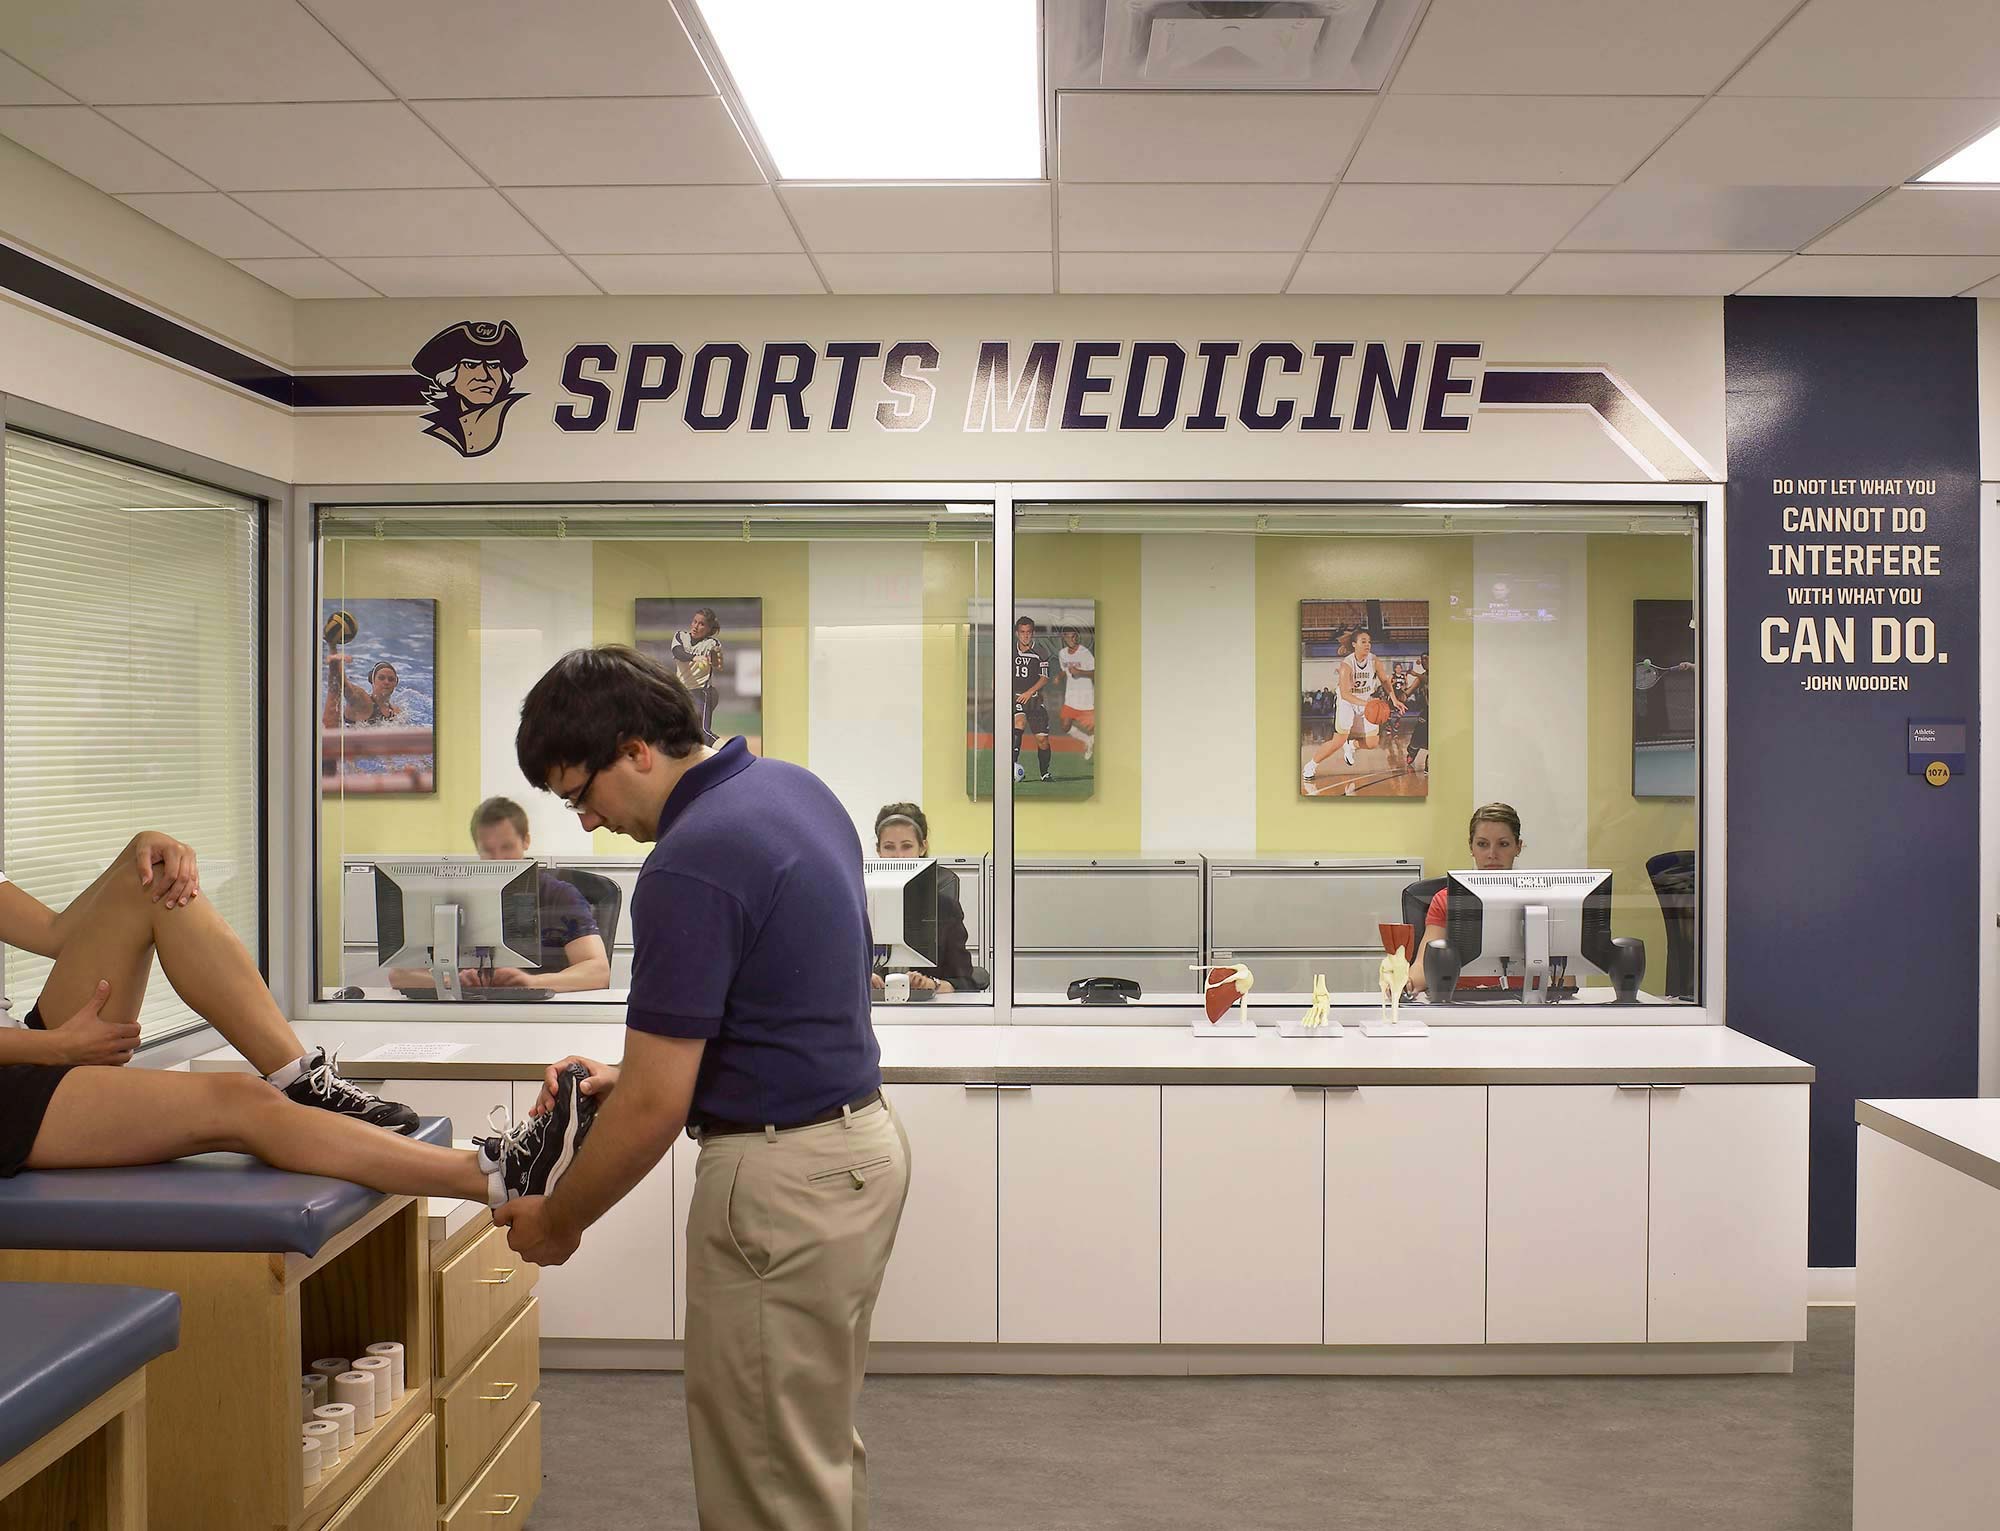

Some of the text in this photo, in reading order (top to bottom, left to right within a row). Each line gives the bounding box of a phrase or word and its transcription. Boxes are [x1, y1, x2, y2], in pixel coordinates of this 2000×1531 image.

[552, 339, 1484, 433] SPORTS MEDICINE
[1773, 479, 1936, 495] DO NOT LET WHAT YOU
[1783, 507, 1926, 533] CANNOT DO
[1768, 544, 1941, 576] INTERFERE
[1787, 587, 1922, 605] WITH WHAT YOU
[1760, 617, 1948, 664] CAN DO.
[1015, 656, 1031, 665] GW
[1015, 666, 1028, 678] 19
[1801, 676, 1908, 691] -JOHN WOODEN
[1928, 768, 1948, 777] 107A
